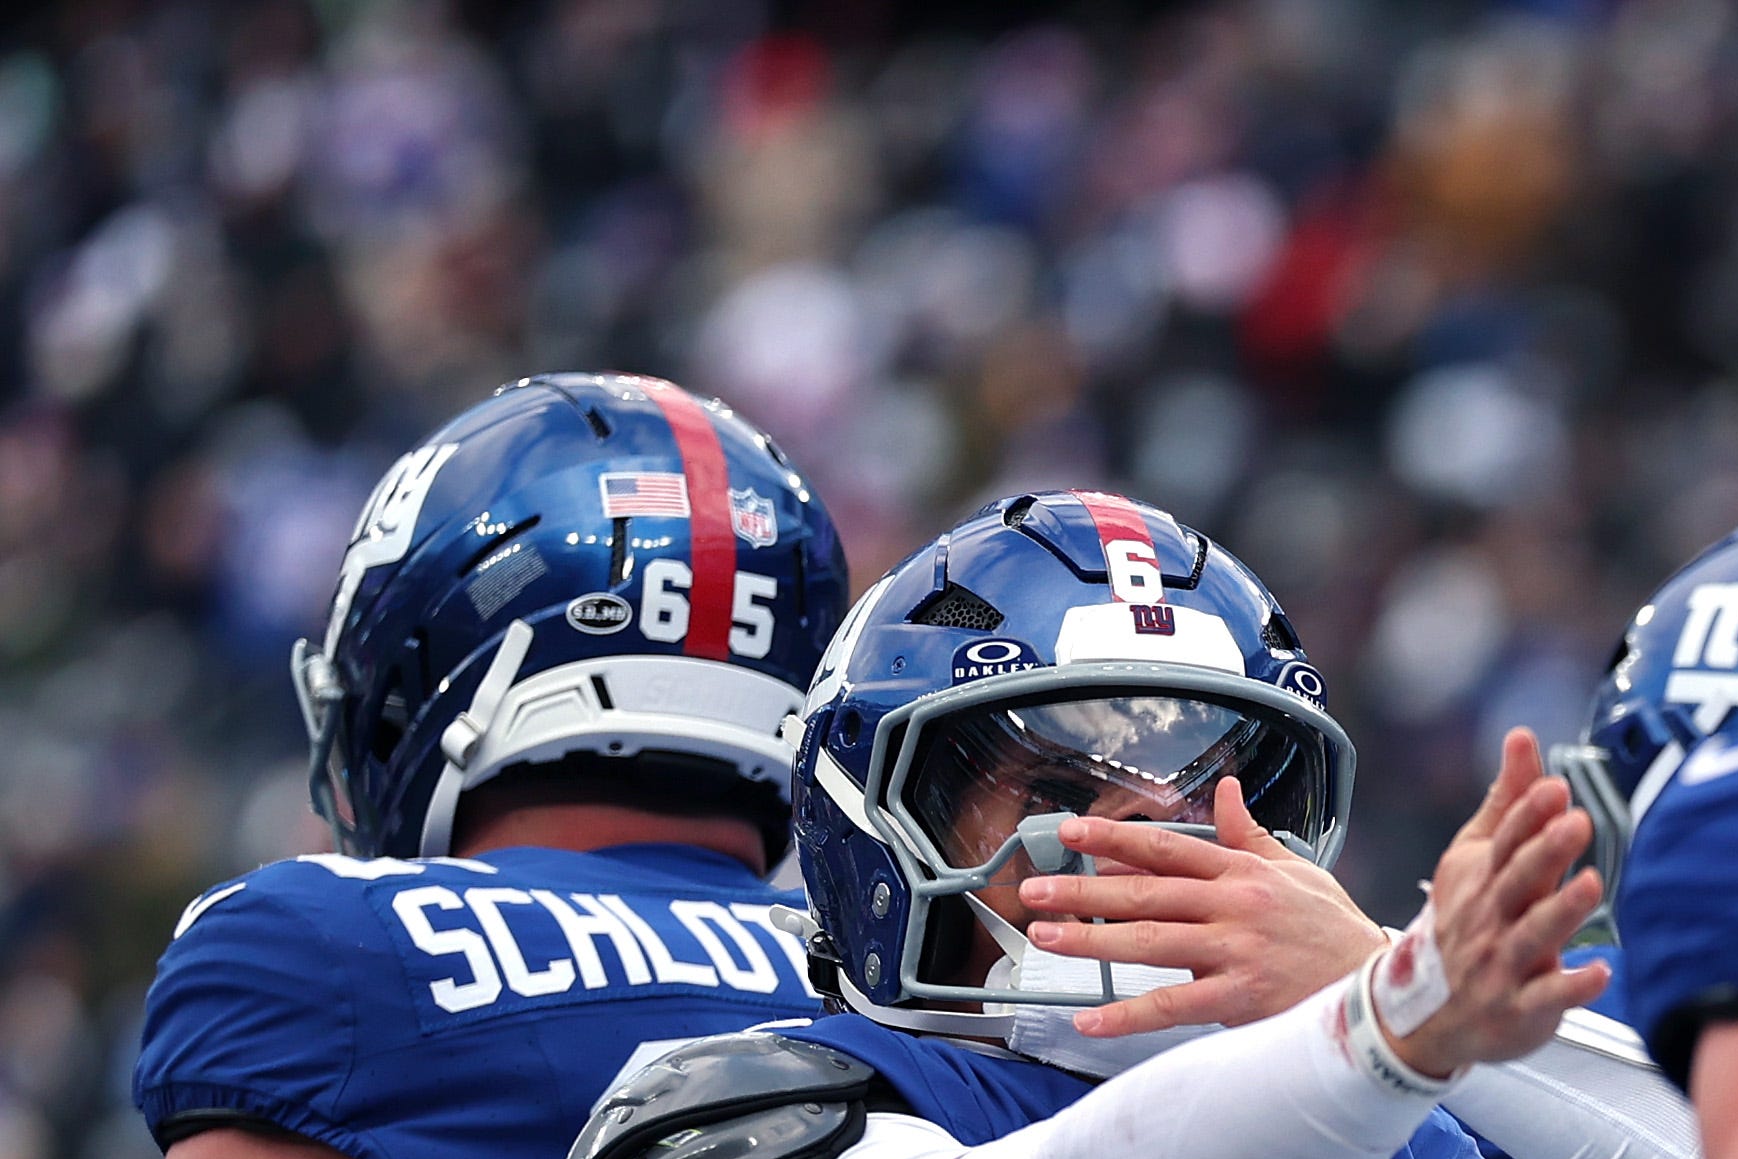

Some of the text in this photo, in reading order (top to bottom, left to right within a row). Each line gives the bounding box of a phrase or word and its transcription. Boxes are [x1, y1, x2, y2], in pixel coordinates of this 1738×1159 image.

[1104, 540, 1164, 603] 6
[639, 558, 777, 659] 65
[955, 662, 1034, 678] OAKLEY
